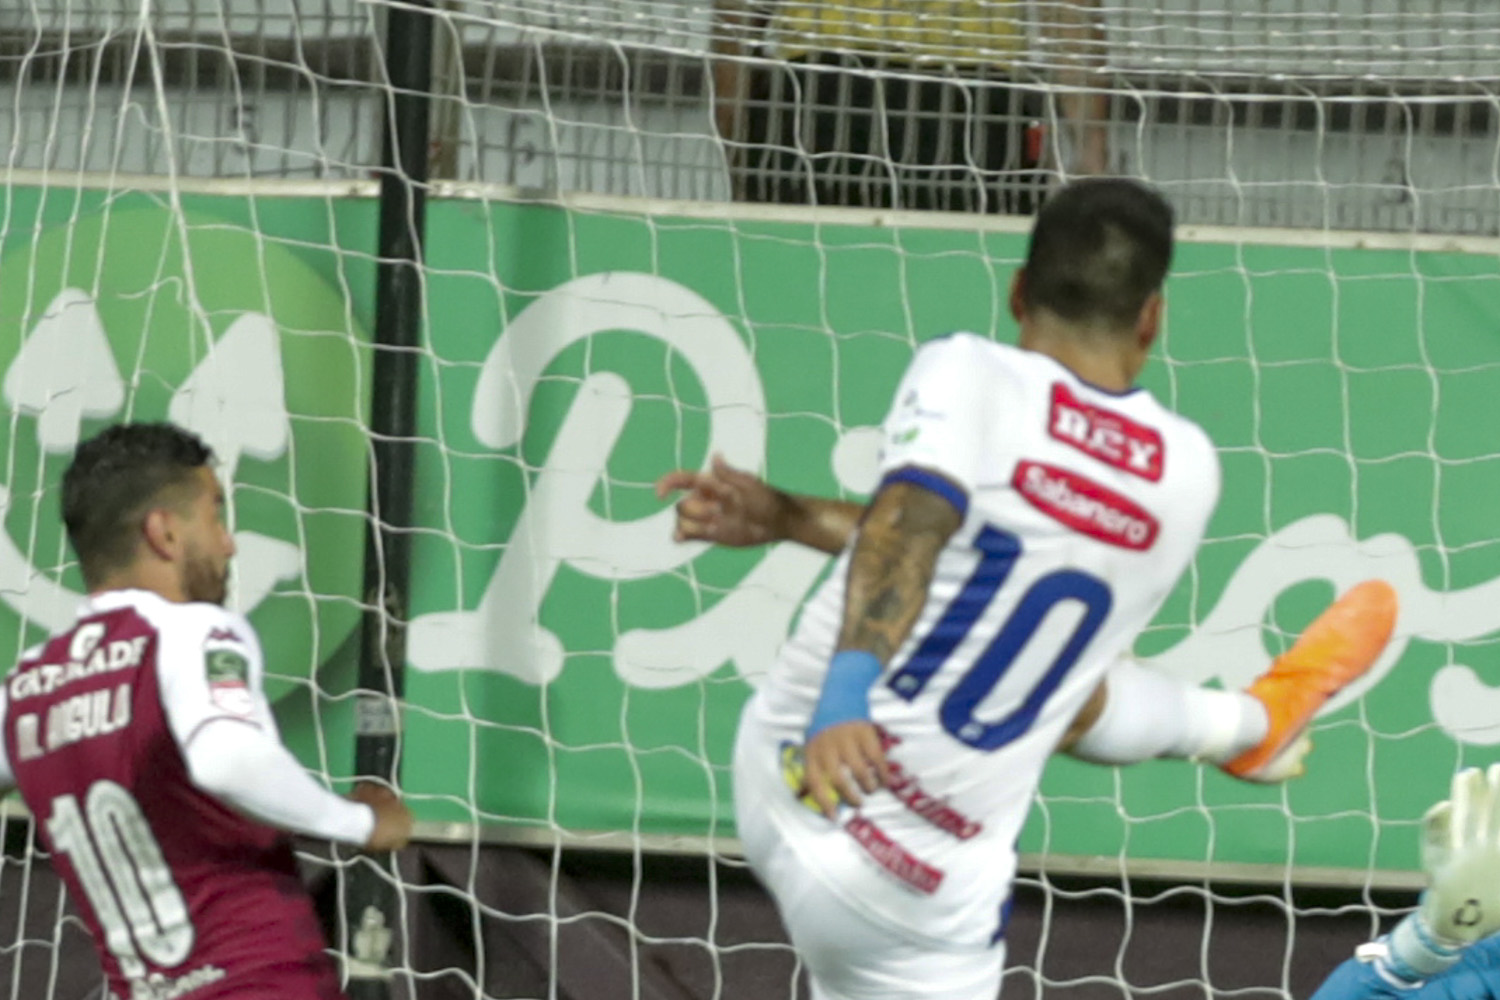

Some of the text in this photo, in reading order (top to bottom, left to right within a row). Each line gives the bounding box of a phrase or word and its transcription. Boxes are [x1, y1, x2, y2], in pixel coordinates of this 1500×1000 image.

[1055, 405, 1158, 470] REY
[886, 520, 1114, 752] 10
[45, 778, 195, 980] 10
